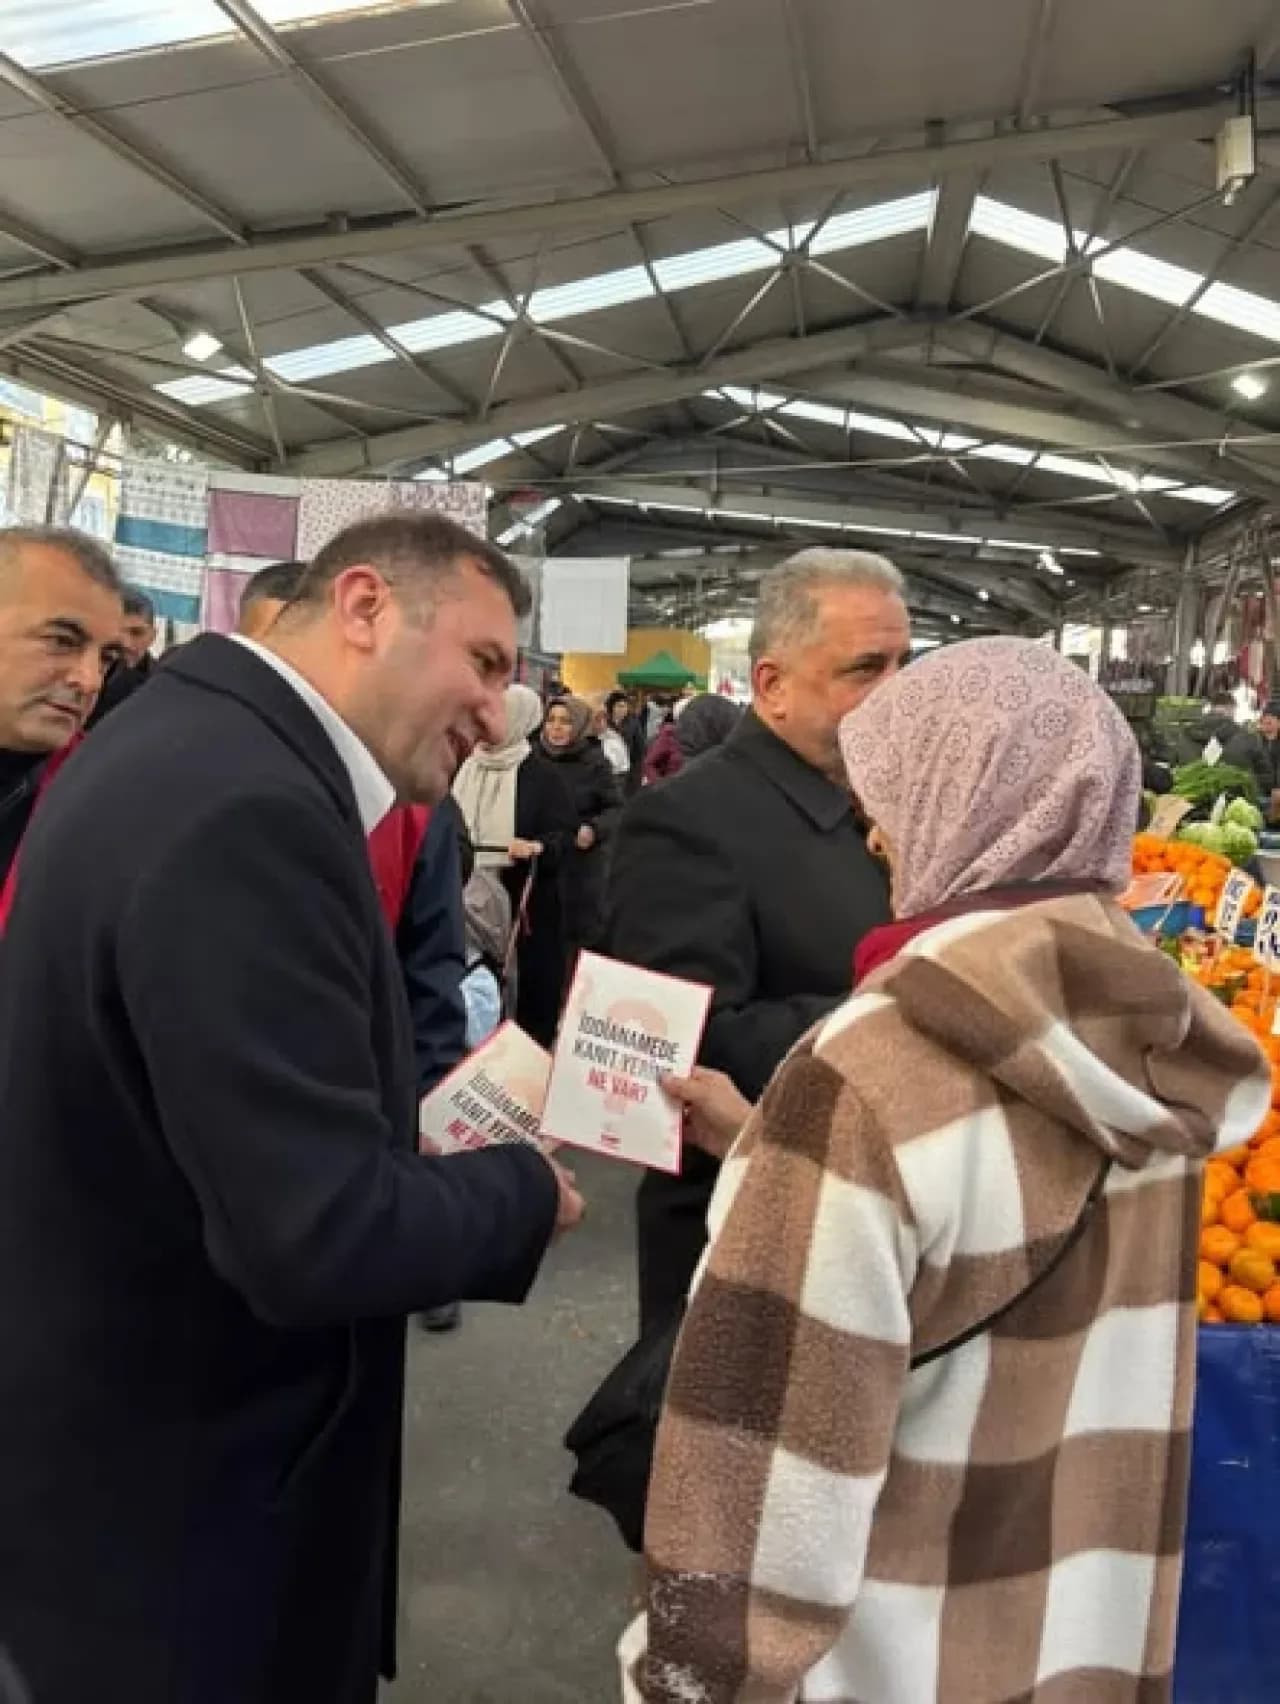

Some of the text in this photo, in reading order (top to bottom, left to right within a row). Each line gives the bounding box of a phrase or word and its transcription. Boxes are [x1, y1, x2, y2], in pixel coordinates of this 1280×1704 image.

[573, 1037, 617, 1068] KANIT
[586, 1066, 649, 1104] NE VAR?
